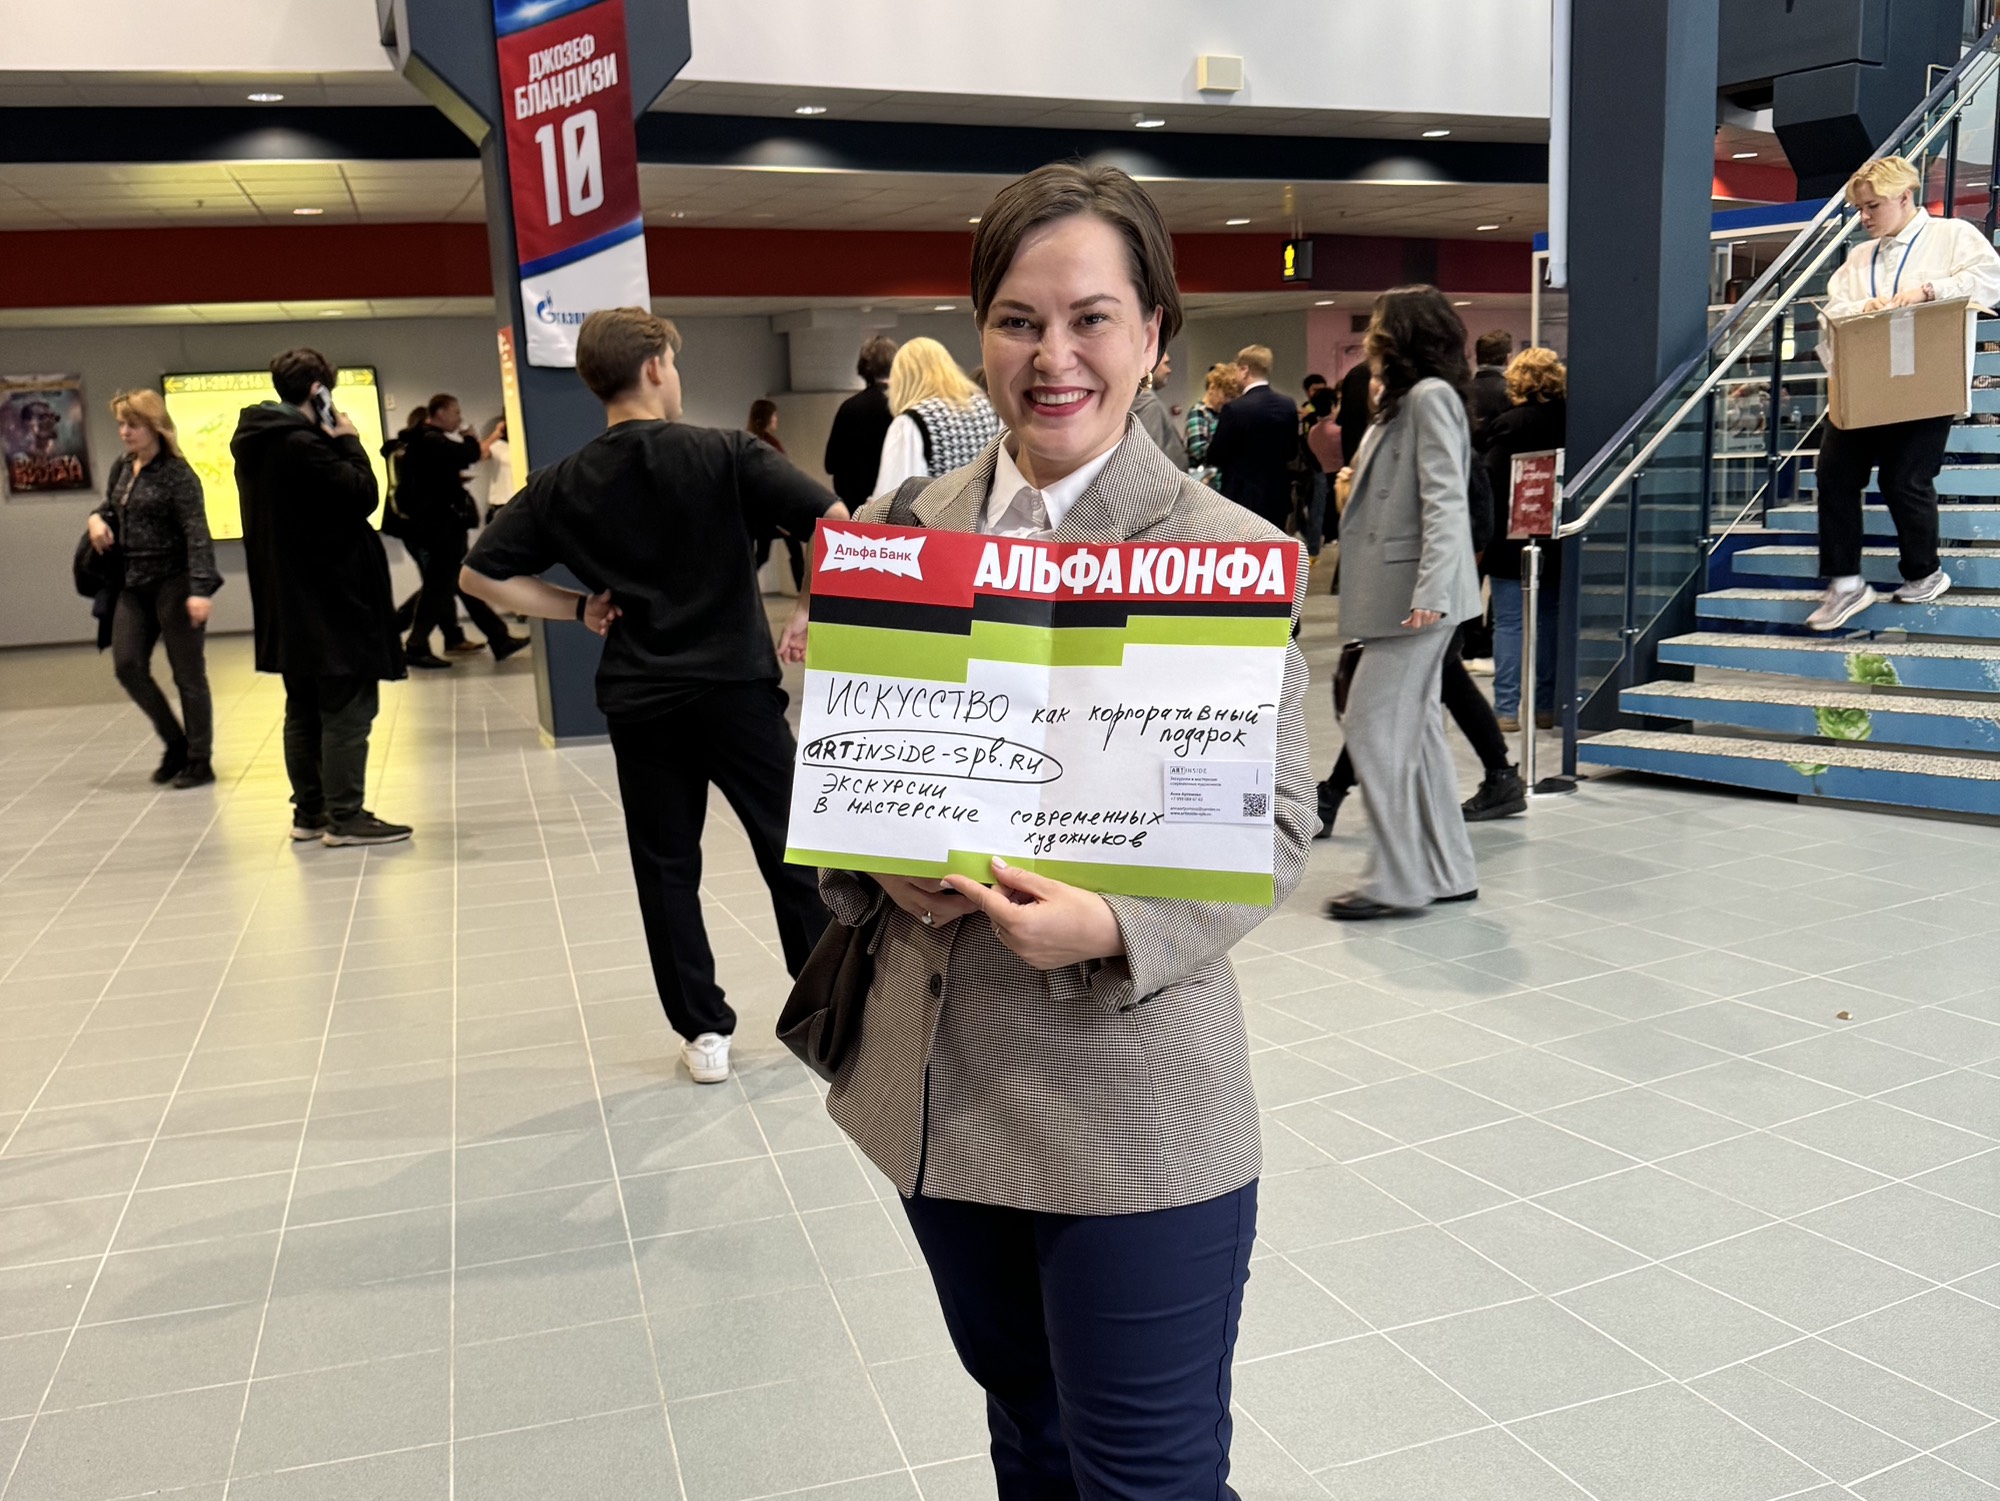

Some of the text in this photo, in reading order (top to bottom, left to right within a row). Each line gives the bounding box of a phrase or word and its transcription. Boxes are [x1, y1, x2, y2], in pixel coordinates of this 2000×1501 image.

[528, 33, 595, 82] ДЖОЗЕФ
[514, 52, 618, 120] БЛАНДИЗИ
[535, 109, 604, 226] 10
[834, 543, 912, 561] Альфа Банк
[973, 541, 1286, 595] АЛЬФА КОНФА
[827, 677, 1275, 751] ИСКУССТВО как корпоративный
[1160, 726, 1248, 757] подарок
[813, 796, 828, 814] В
[821, 773, 948, 799] ЭКСКУРСИИ
[1024, 829, 1148, 855] художников
